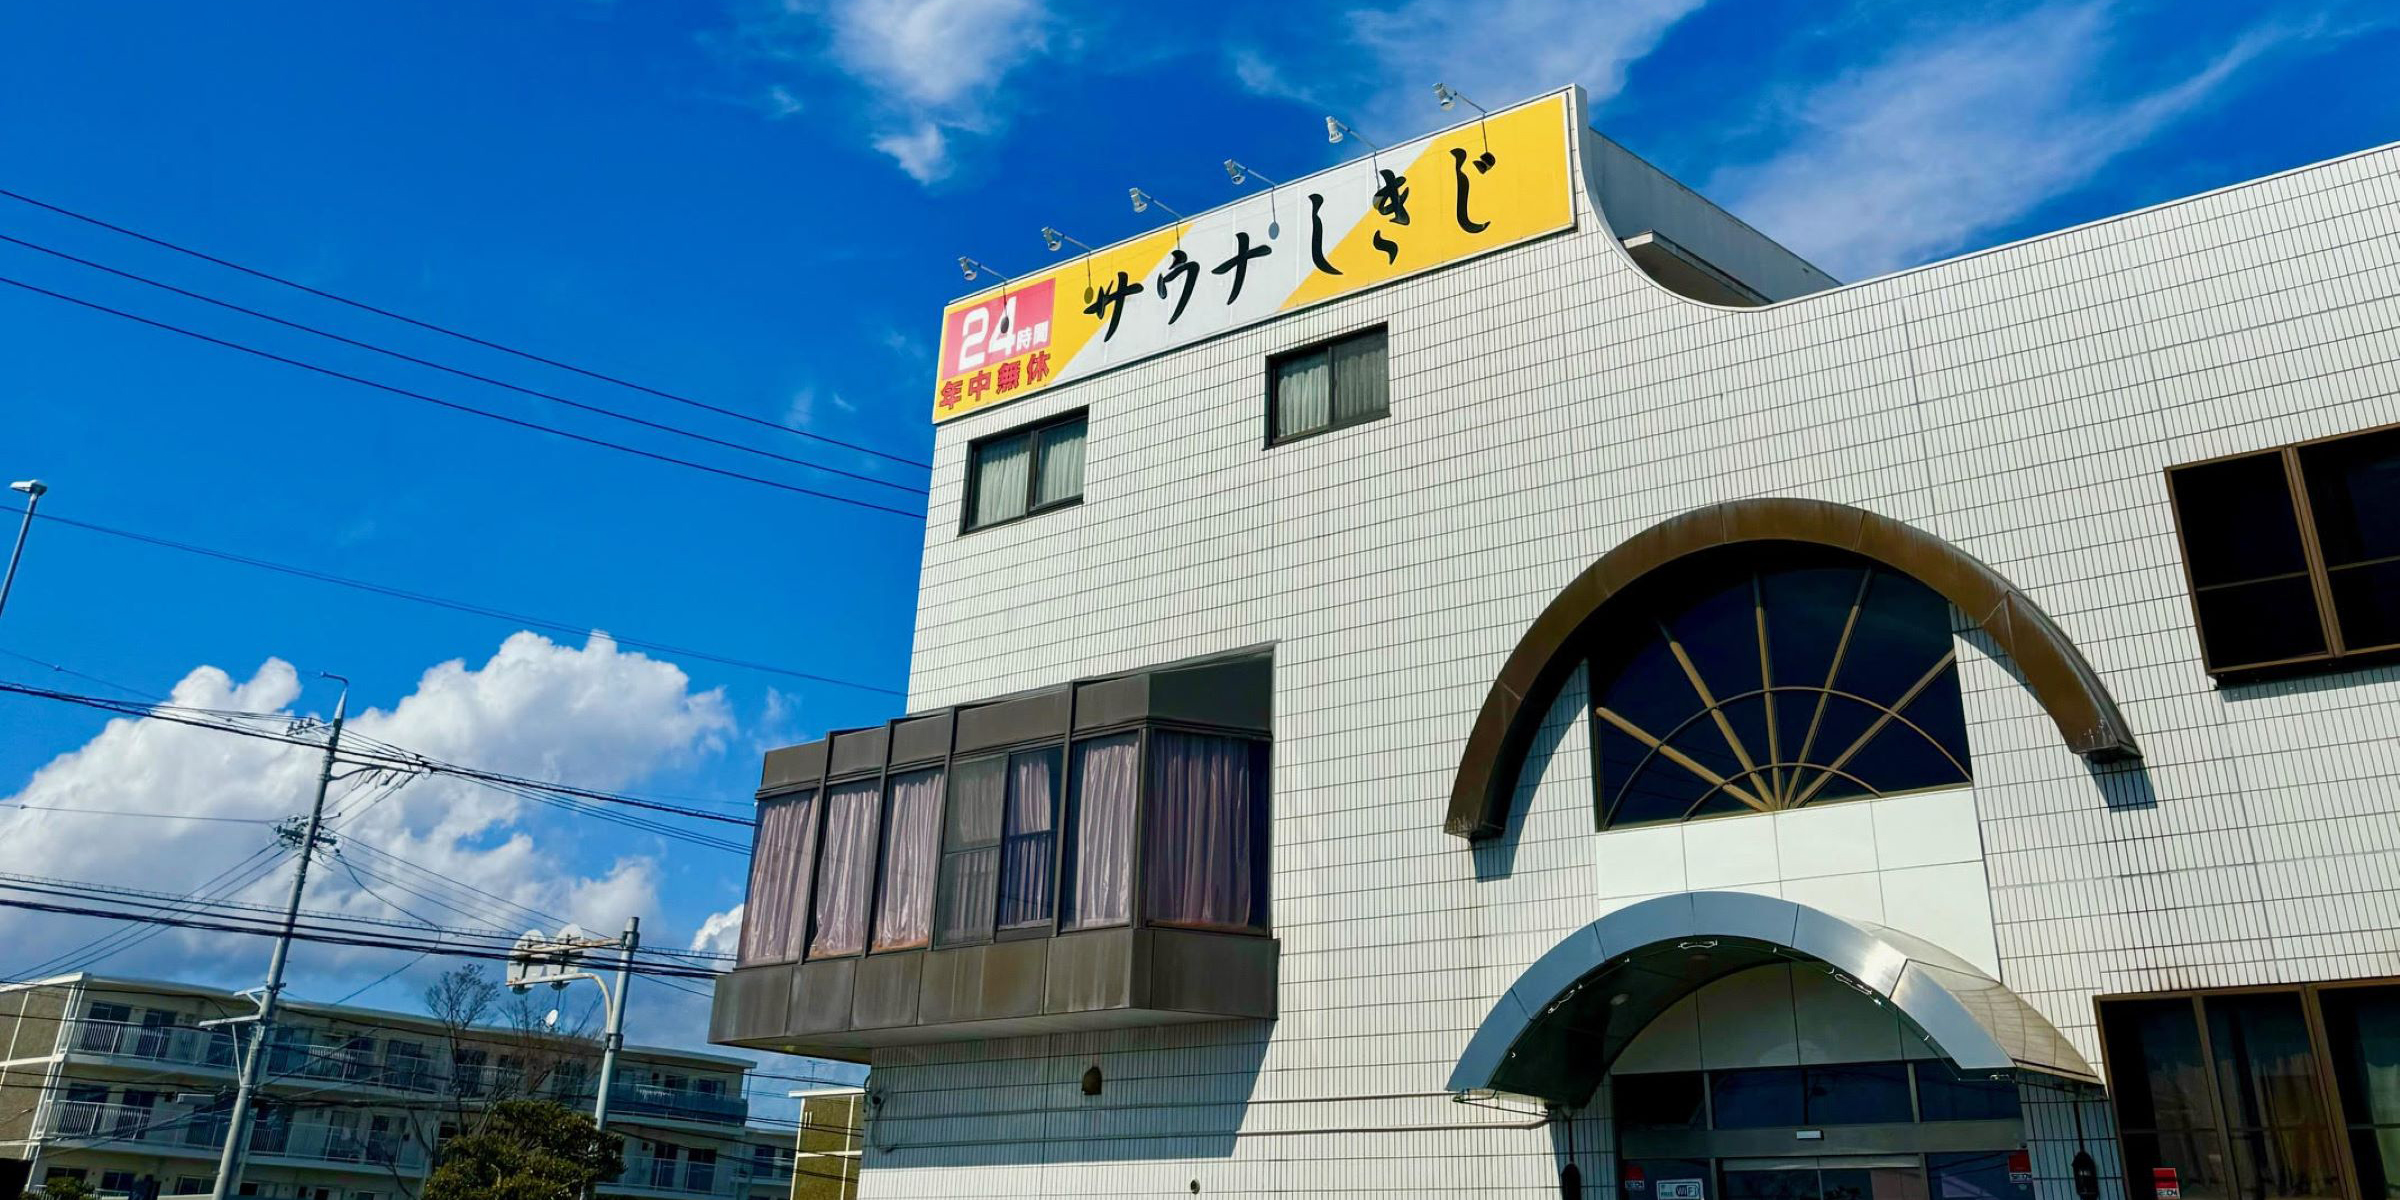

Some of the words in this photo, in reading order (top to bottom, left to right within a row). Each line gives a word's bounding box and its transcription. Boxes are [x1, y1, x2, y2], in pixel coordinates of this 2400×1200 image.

[1084, 148, 1496, 342] サウナしきじ
[958, 296, 1049, 371] 24時間
[939, 351, 1051, 410] 年中無休
